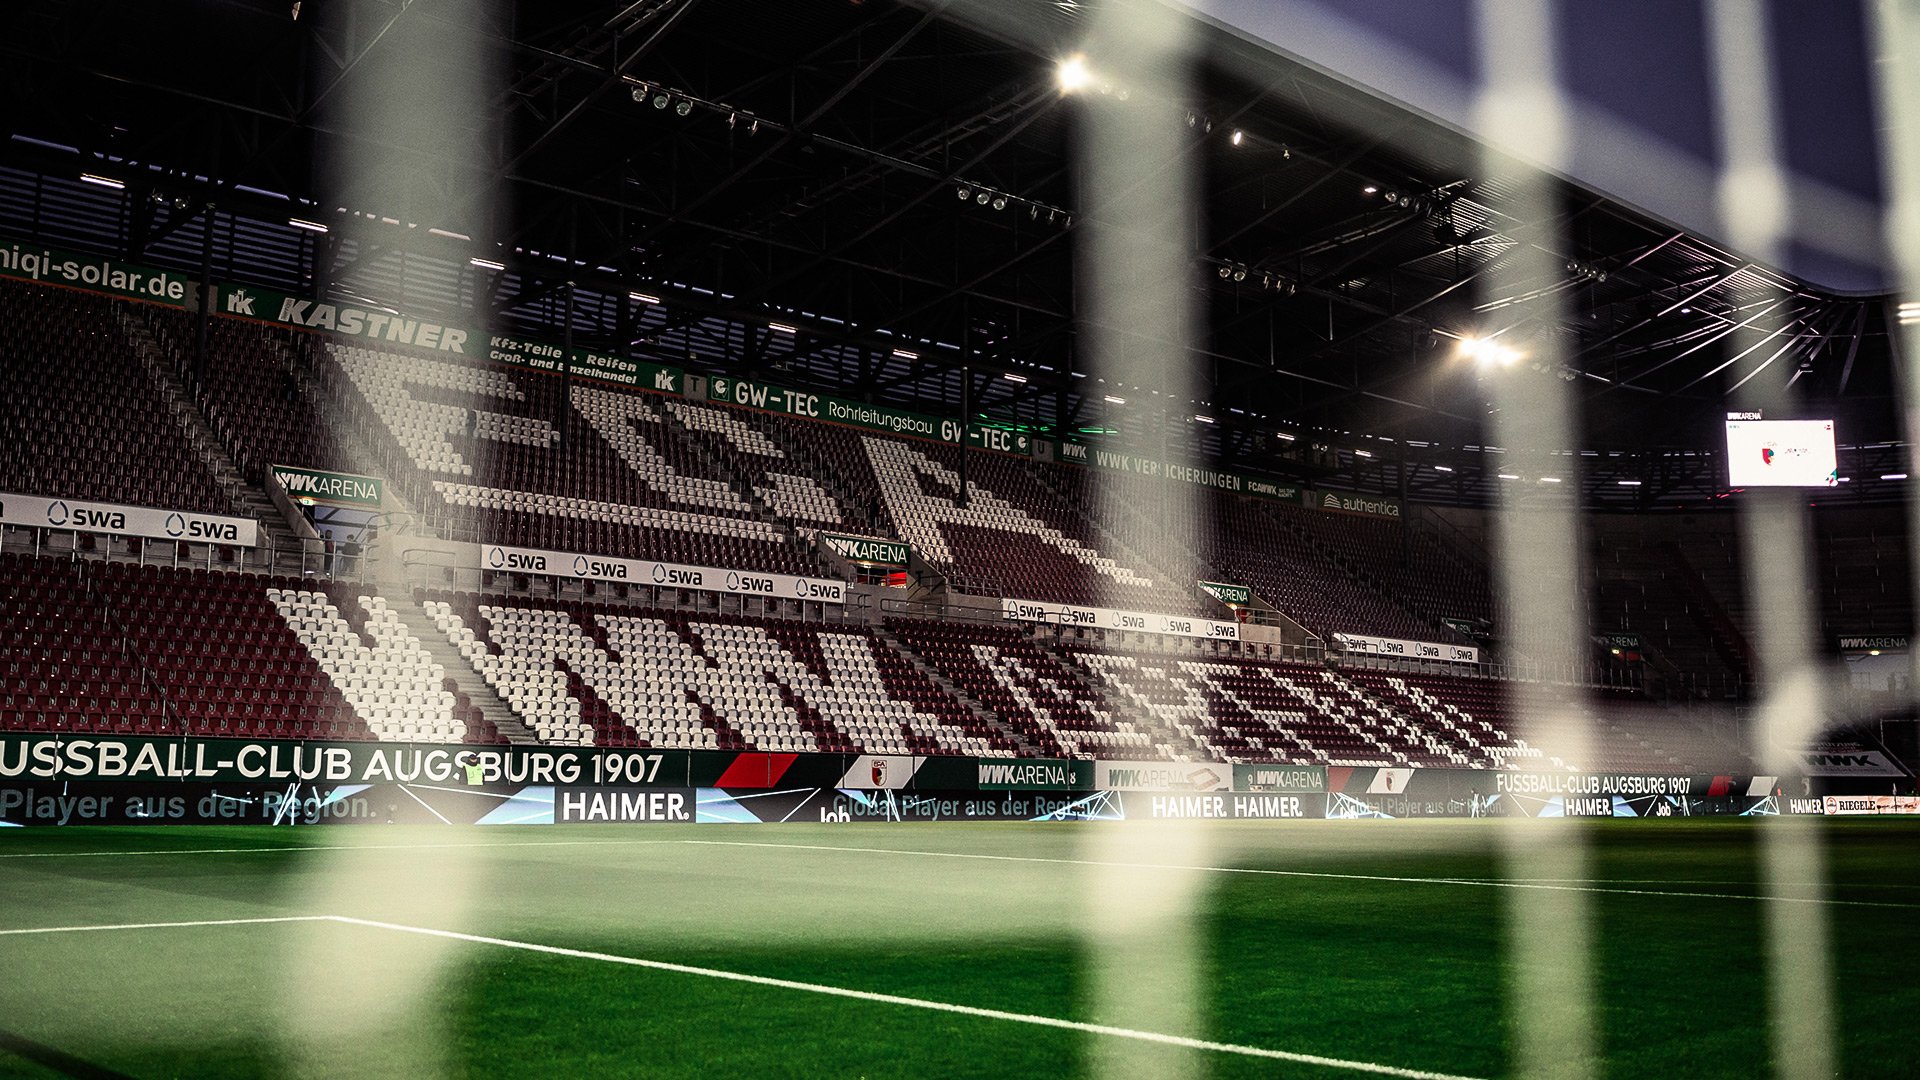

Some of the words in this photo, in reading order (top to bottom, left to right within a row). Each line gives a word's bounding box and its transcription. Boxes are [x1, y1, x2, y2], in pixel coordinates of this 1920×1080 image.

[278, 297, 468, 354] KASTNER
[490, 336, 563, 358] Kfz-Teile
[586, 354, 637, 372] Reifen
[490, 350, 526, 363] Groß-
[529, 358, 554, 369] und
[557, 362, 637, 384] Enzelhandel
[735, 381, 819, 417] GW-TEC
[829, 401, 933, 434] Rohrleitungsbau
[1062, 442, 1087, 459] WWK
[1096, 450, 1130, 471] WWK
[1343, 498, 1399, 517] authentica
[72, 508, 126, 530] swa
[189, 518, 238, 541] swa
[507, 554, 546, 571] swa
[590, 561, 627, 579] swa
[668, 569, 703, 586] swa
[741, 576, 774, 593] swa
[810, 583, 840, 599] swa
[1019, 605, 1044, 619] swa
[1072, 609, 1096, 624] swa
[1122, 615, 1145, 629] swa
[1169, 620, 1191, 633] swa
[1215, 624, 1236, 638] swa
[1350, 638, 1367, 650] swa
[1386, 642, 1404, 654] swa
[1423, 646, 1440, 657] swa
[1456, 649, 1473, 661] swa
[1840, 637, 1908, 649] WWKARENA
[0, 740, 352, 781] USSBALL-CLUB
[362, 749, 581, 783] AUGSBURG
[591, 753, 664, 783] 1907
[978, 764, 1066, 785] WWKARENA
[1069, 771, 1077, 785] 8
[1108, 769, 1186, 787] WWKARENA
[1247, 775, 1253, 785] 9
[1256, 770, 1323, 788] WWKARENA
[1496, 773, 1600, 794] FUSSBALL-CLUB
[1602, 775, 1666, 795] AUGSBURG
[1667, 777, 1691, 794] 1907
[1, 788, 114, 825] Player
[125, 795, 185, 818] aus
[198, 790, 256, 818] der
[902, 794, 962, 821] Player
[965, 800, 996, 816] aus
[1001, 796, 1030, 816] der
[1838, 800, 1876, 811] RIEGELE
